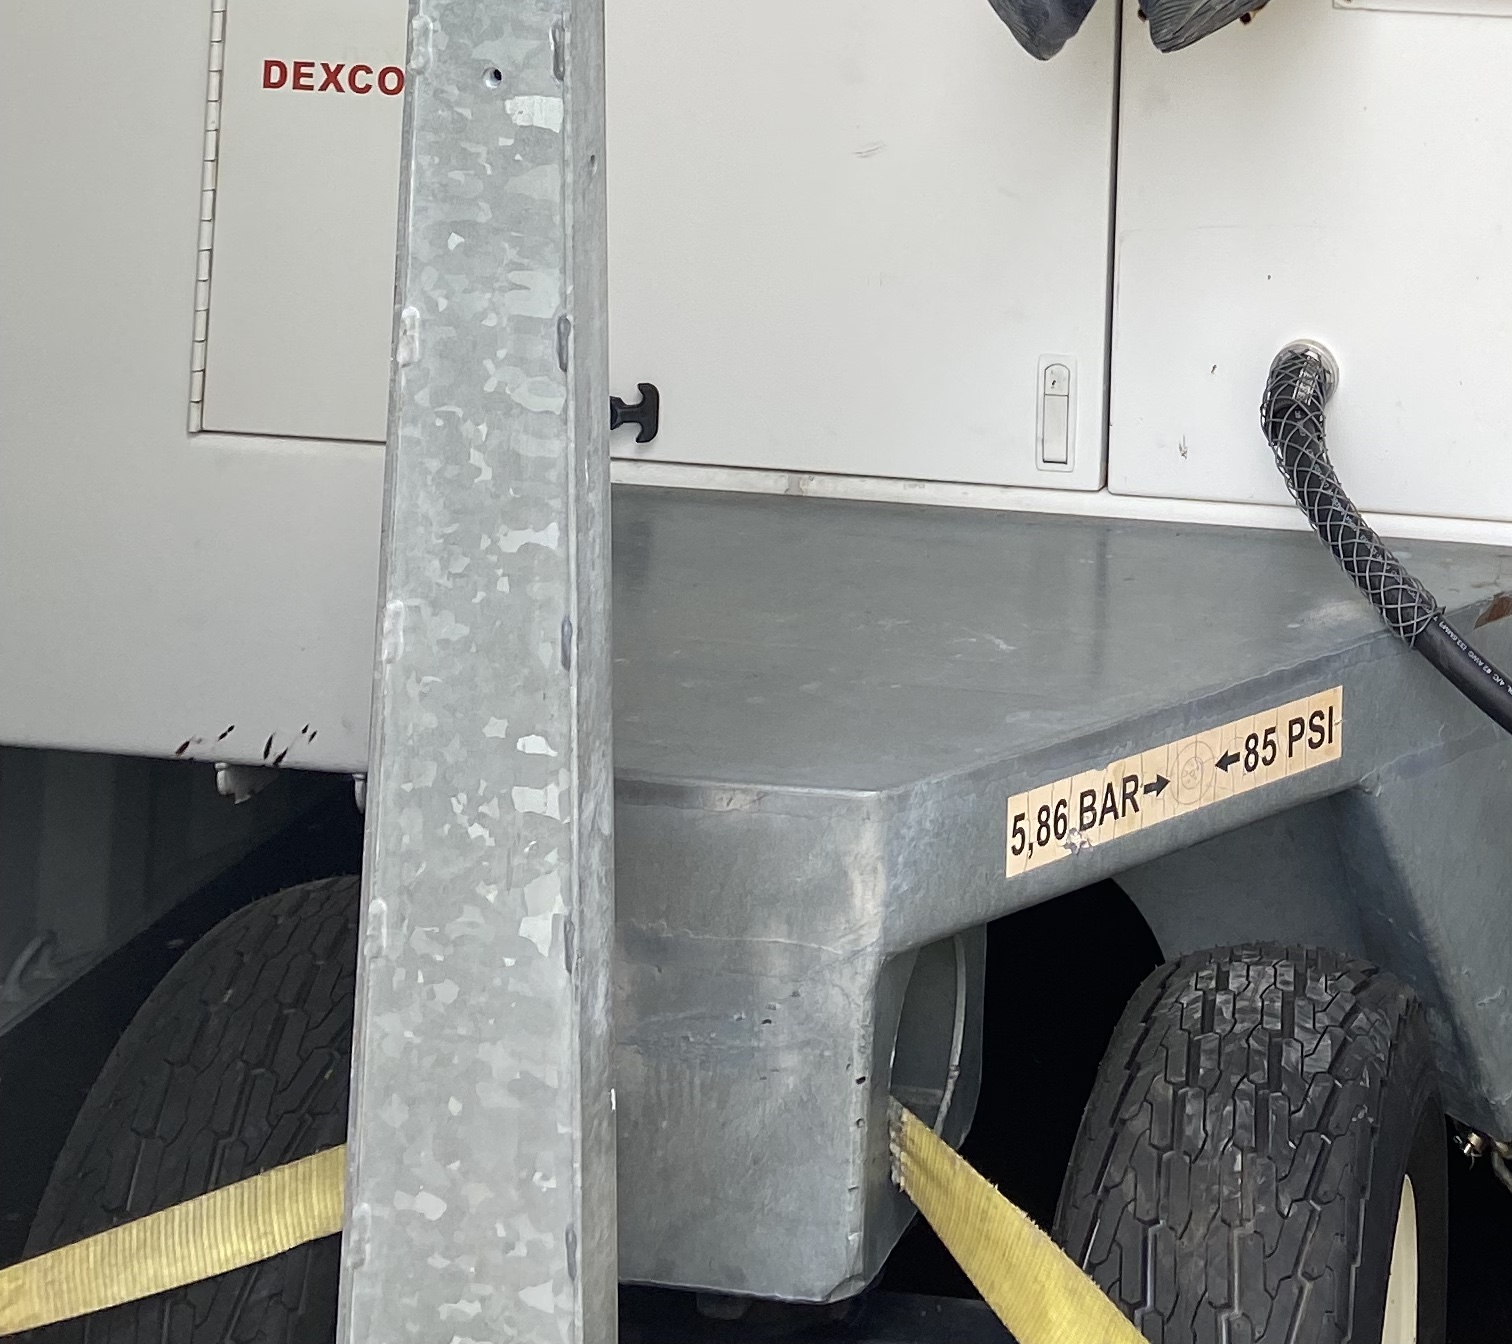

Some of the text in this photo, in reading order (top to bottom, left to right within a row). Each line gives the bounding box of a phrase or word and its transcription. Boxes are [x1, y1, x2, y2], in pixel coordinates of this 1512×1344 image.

[1467, 650, 1484, 667] AWG
[1492, 673, 1506, 687] 4/C
[1010, 705, 1334, 860] 5,86 BAR 85 PSI
